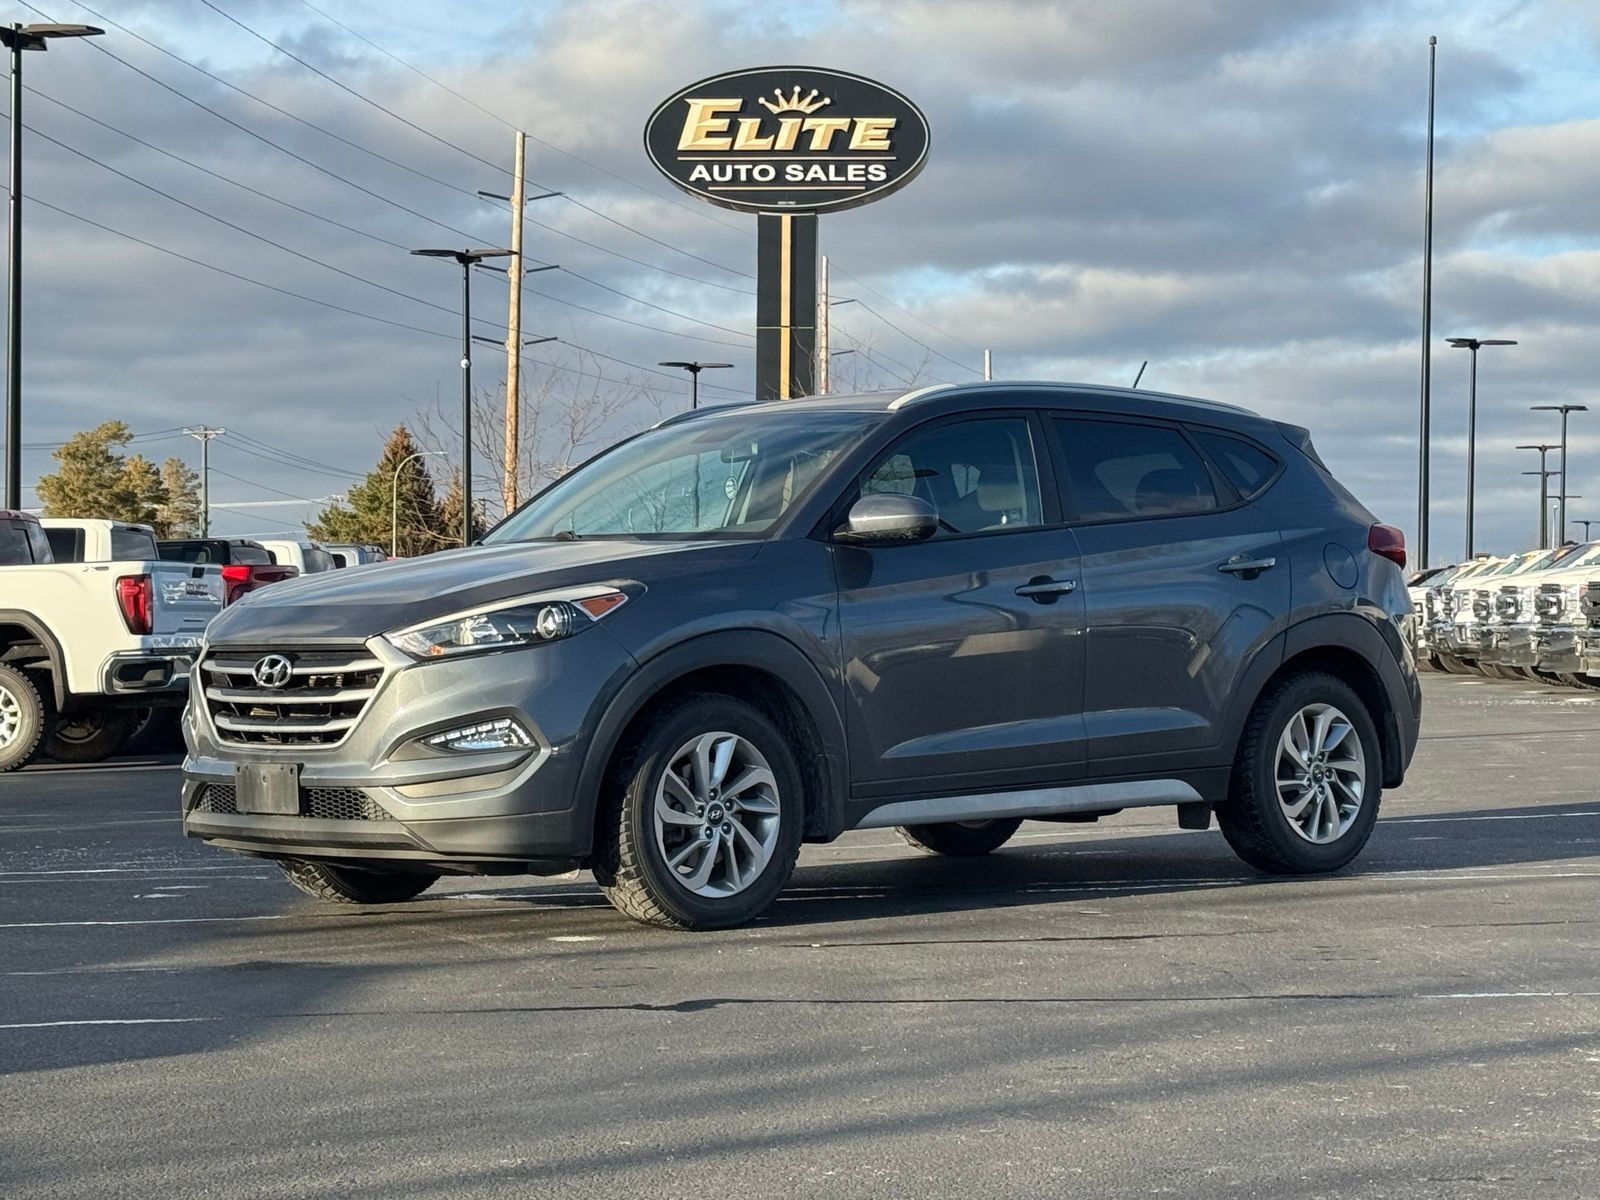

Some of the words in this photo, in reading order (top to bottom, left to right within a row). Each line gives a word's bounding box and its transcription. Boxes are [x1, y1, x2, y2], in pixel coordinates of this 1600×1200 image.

[677, 98, 897, 151] ELITE
[689, 164, 776, 182] AUTO
[784, 164, 887, 182] SALES
